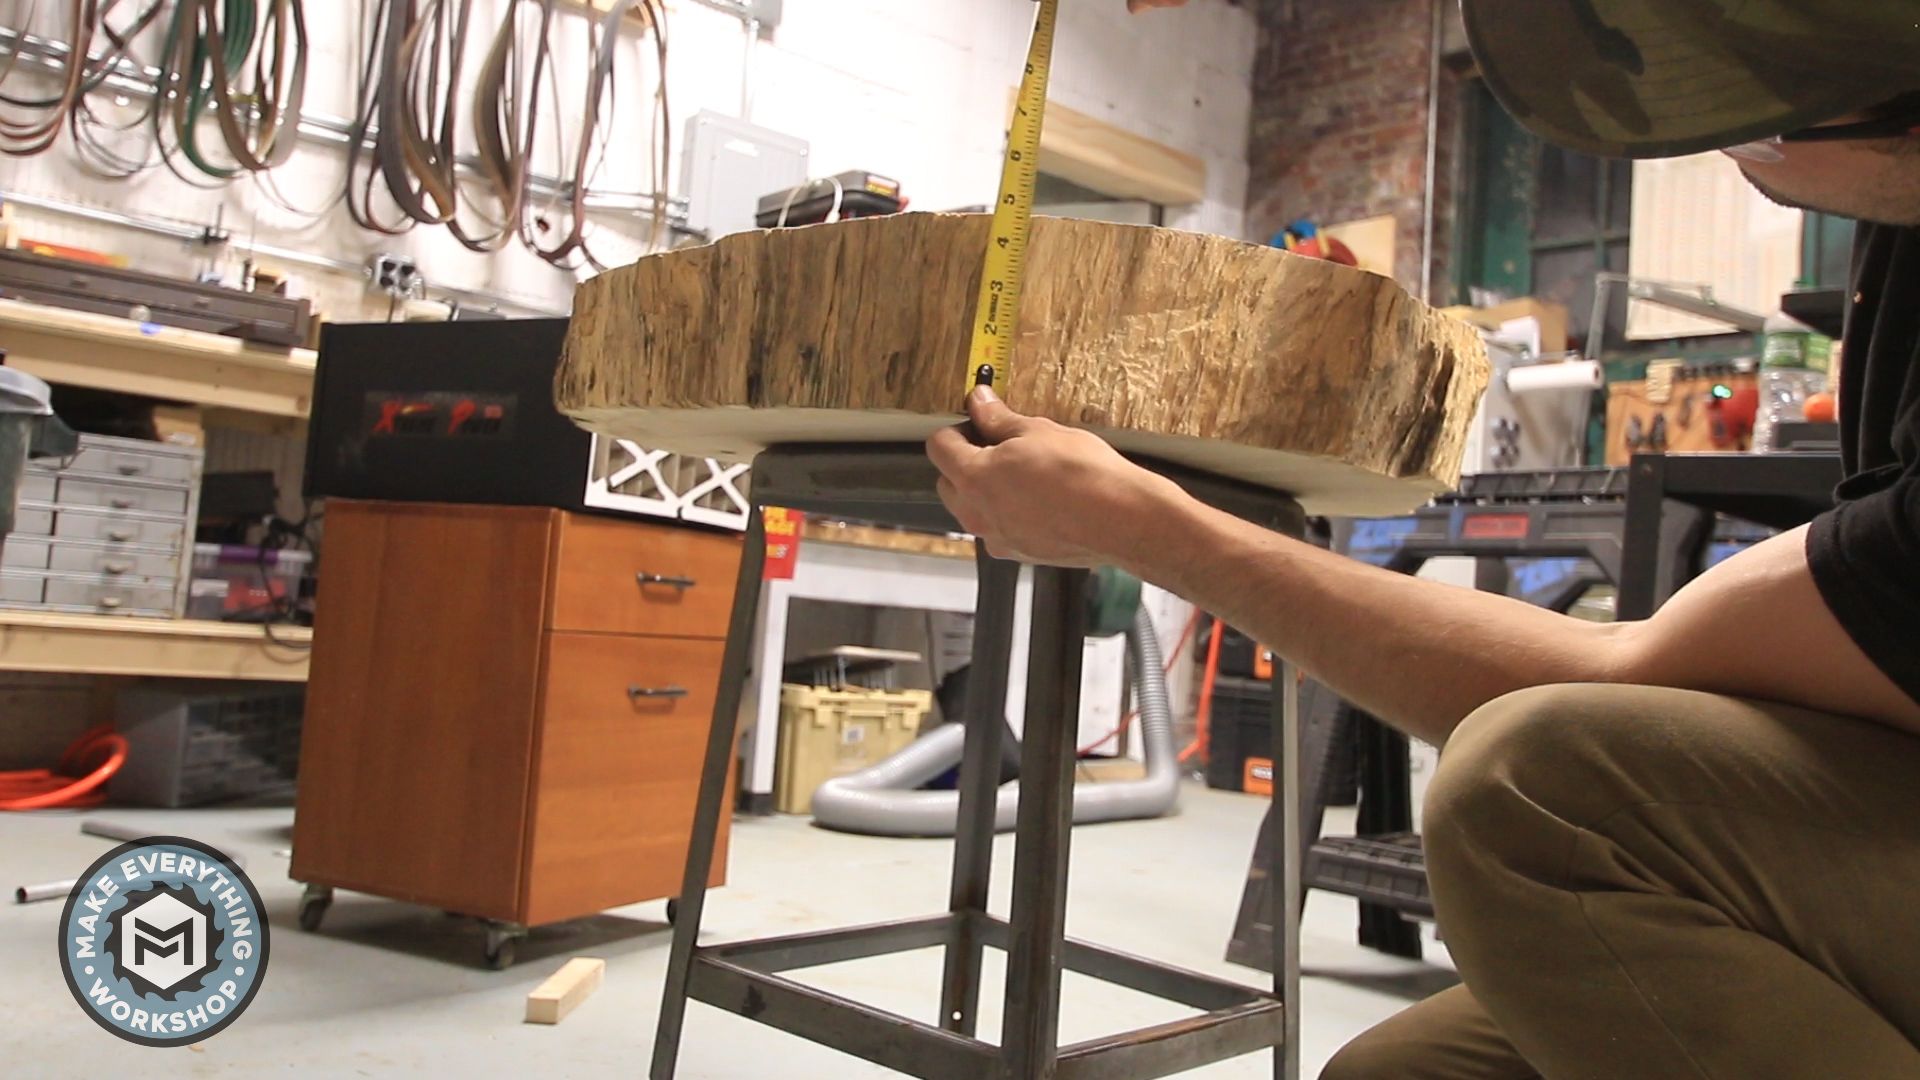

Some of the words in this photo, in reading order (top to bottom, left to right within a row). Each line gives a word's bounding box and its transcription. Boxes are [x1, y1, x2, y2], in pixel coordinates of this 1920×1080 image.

[1017, 104, 1028, 116] 7
[1010, 150, 1022, 162] 6
[1003, 193, 1015, 205] 5
[997, 236, 1010, 249] 4
[990, 280, 1004, 292] 3
[984, 323, 997, 335] 2
